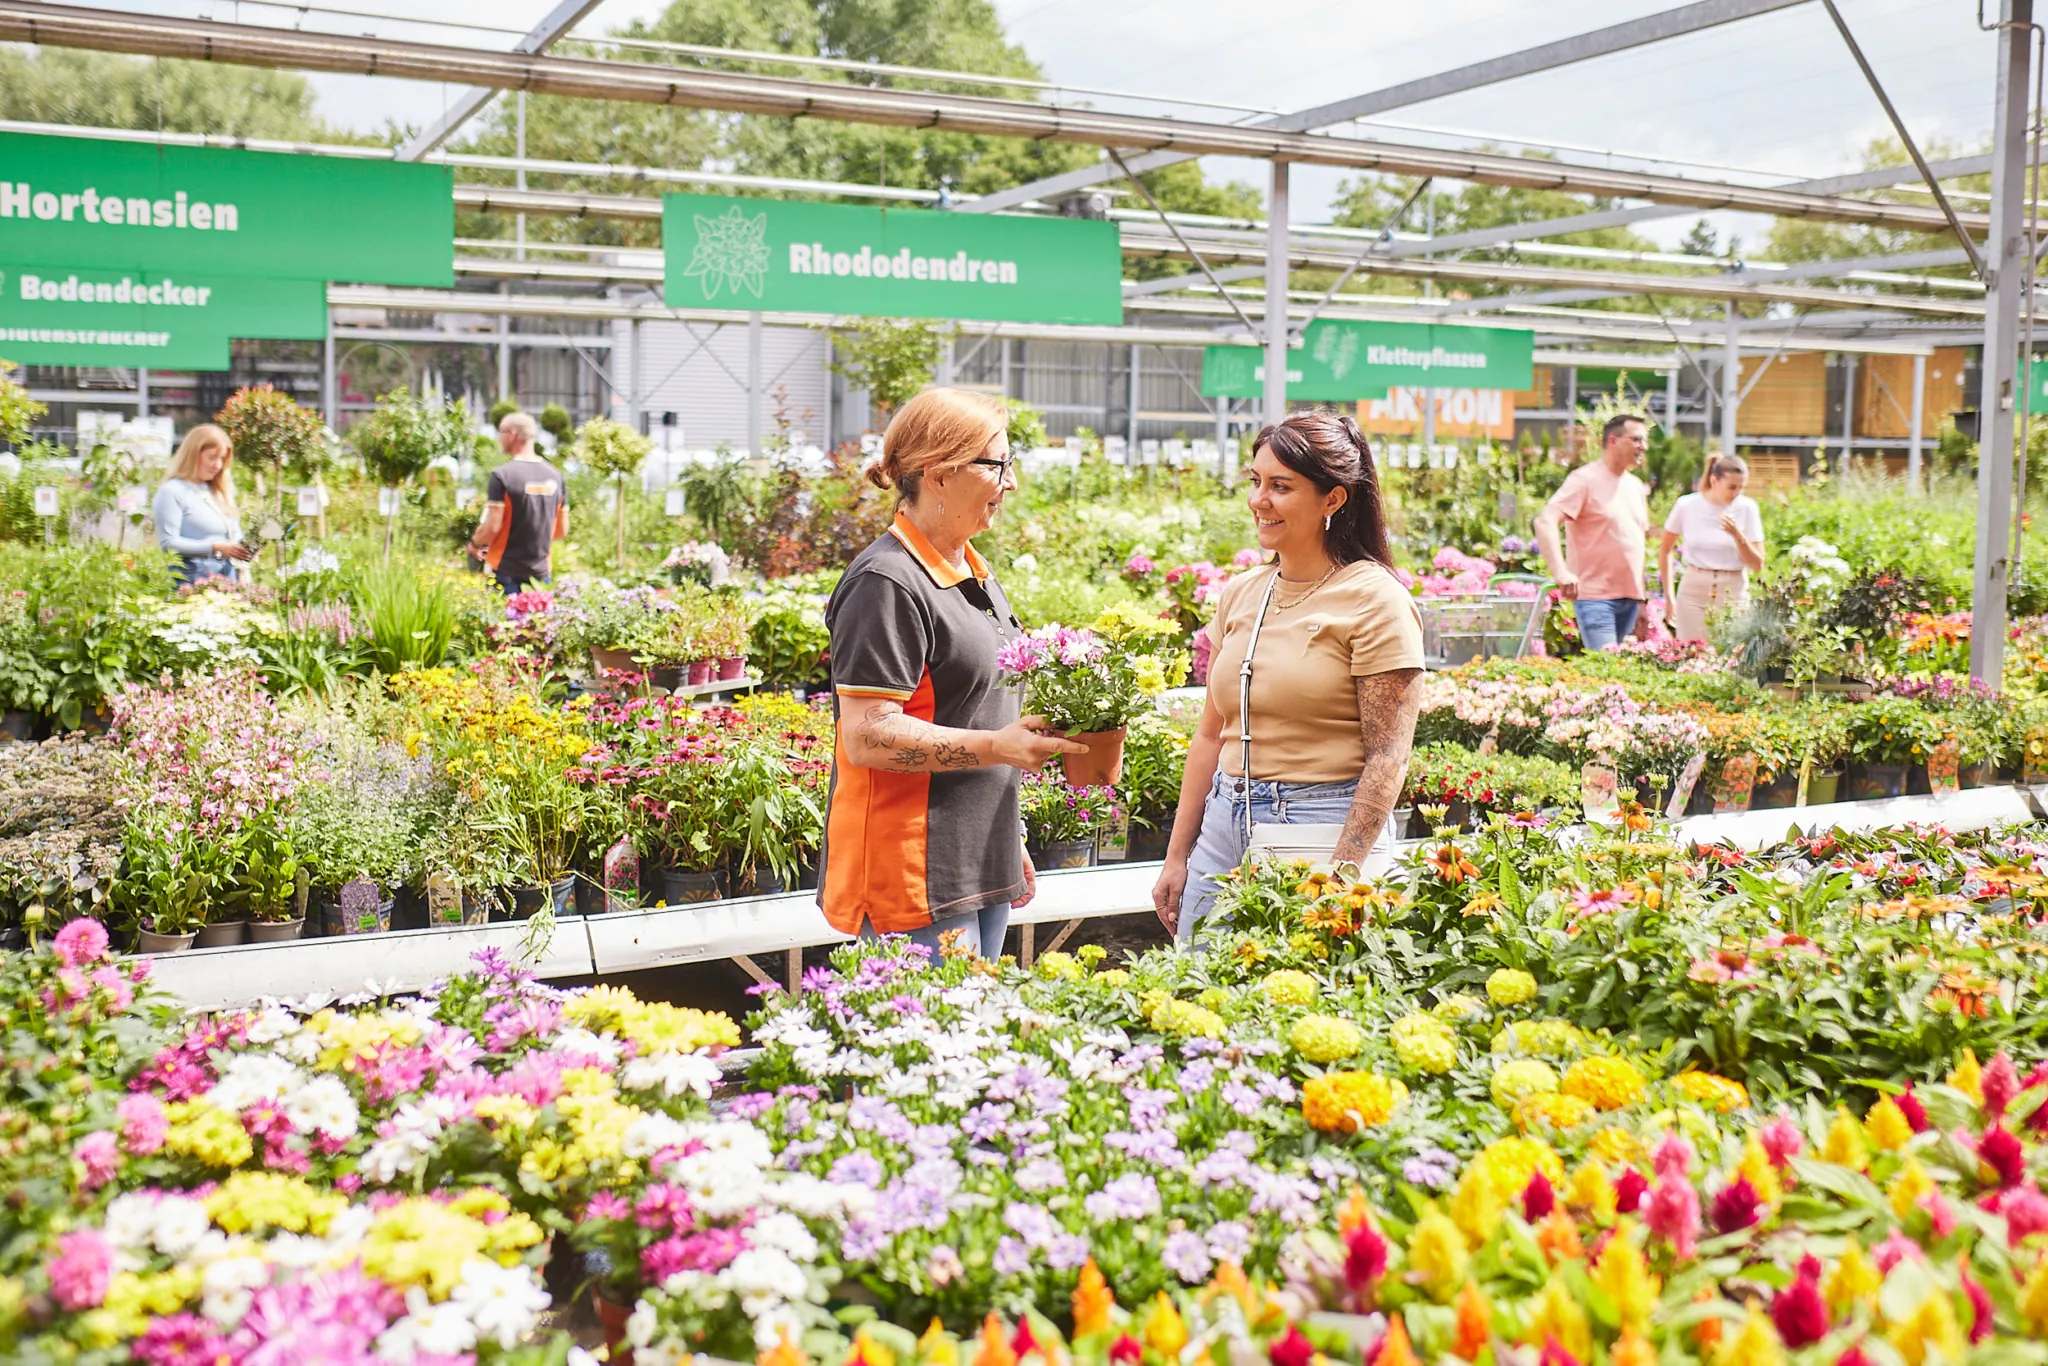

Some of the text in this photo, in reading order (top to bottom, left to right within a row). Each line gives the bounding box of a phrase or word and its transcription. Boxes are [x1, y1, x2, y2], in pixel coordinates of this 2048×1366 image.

[0, 181, 239, 232] Hortensien
[788, 243, 1018, 285] Rhododendren
[20, 274, 212, 306] Bodendecker
[1366, 345, 1487, 371] Kletterpflanzen
